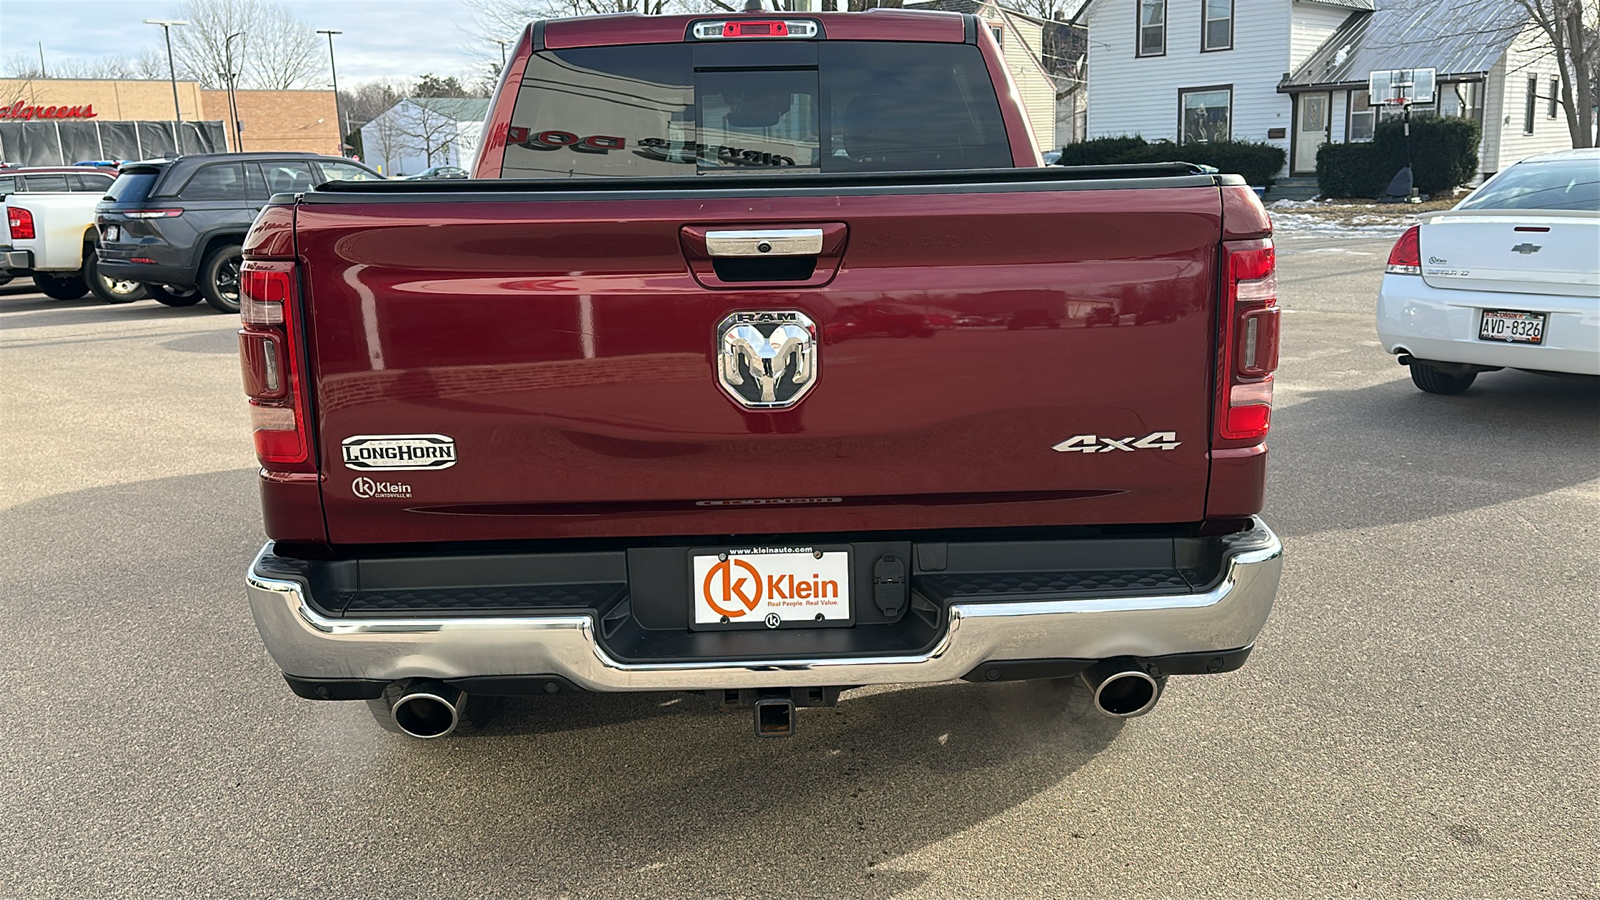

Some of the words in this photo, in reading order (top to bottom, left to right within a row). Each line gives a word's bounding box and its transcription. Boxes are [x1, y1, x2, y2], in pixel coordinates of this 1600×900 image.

[738, 313, 796, 322] RAM
[1482, 318, 1541, 337] AVD-8326
[1051, 431, 1182, 453] 4x4
[376, 482, 412, 493] Klein
[729, 547, 813, 555] www.kleinauto.com
[767, 573, 839, 600] Klein
[782, 600, 803, 608] People.
